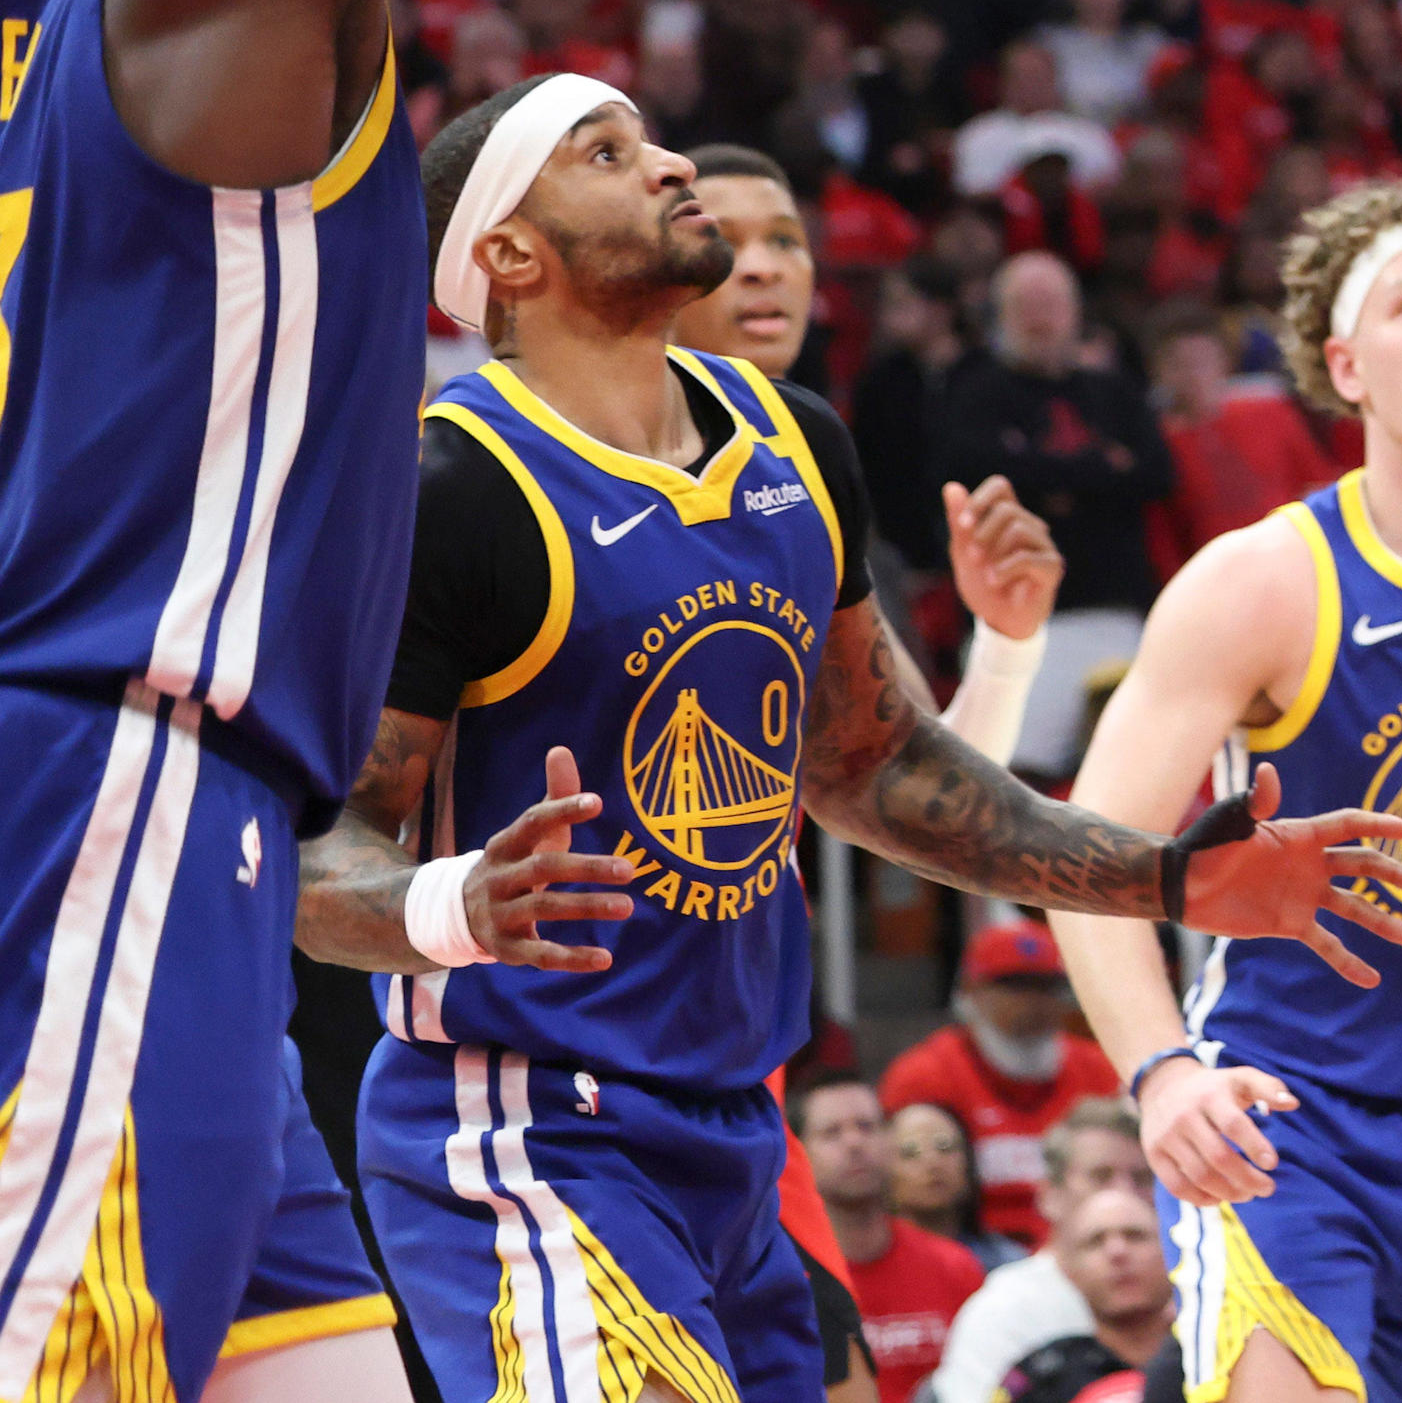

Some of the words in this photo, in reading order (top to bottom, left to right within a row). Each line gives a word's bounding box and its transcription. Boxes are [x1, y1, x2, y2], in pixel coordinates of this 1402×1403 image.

[743, 482, 810, 512] Rakuten
[623, 579, 738, 678] GOLDEN
[750, 581, 818, 653] STATE
[762, 679, 790, 748] 0
[612, 809, 796, 922] WARRIOR
